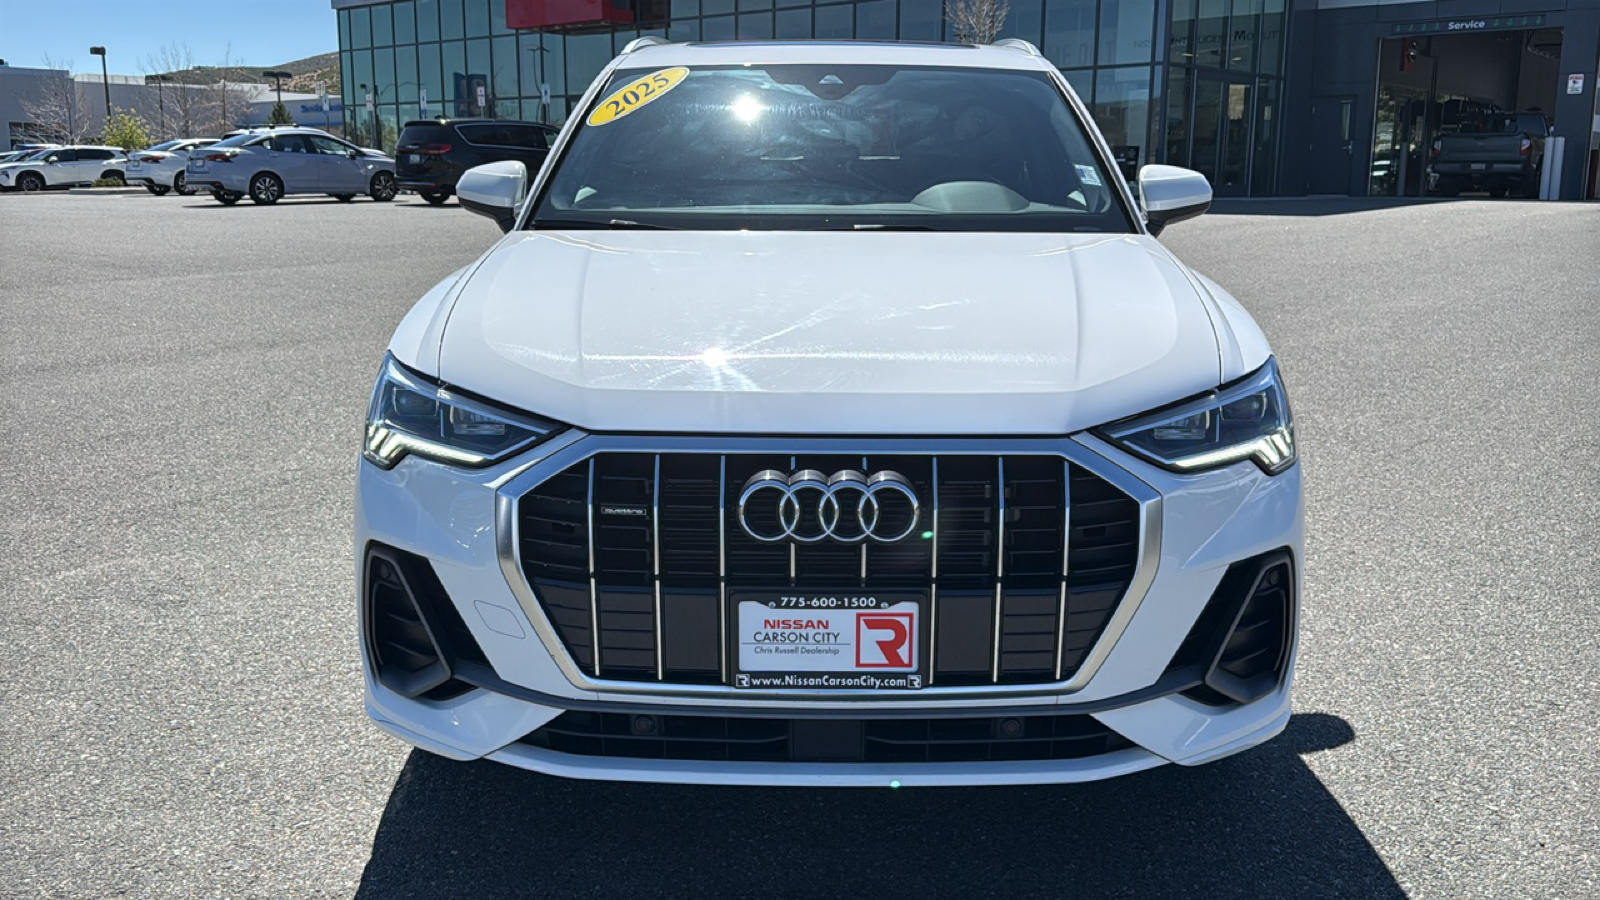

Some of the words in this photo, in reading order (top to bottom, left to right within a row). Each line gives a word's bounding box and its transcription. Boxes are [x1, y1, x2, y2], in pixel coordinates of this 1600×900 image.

[1448, 20, 1485, 30] Service
[606, 73, 669, 117] 2025
[780, 596, 876, 607] 775-600-1500
[764, 619, 829, 630] NISSAN
[753, 631, 809, 643] CARSON
[813, 631, 840, 643] CITY
[754, 646, 773, 655] Chris
[774, 646, 799, 655] Russell
[800, 646, 839, 656] Dealership
[751, 675, 906, 689] www.NissanCarsonCity.com
